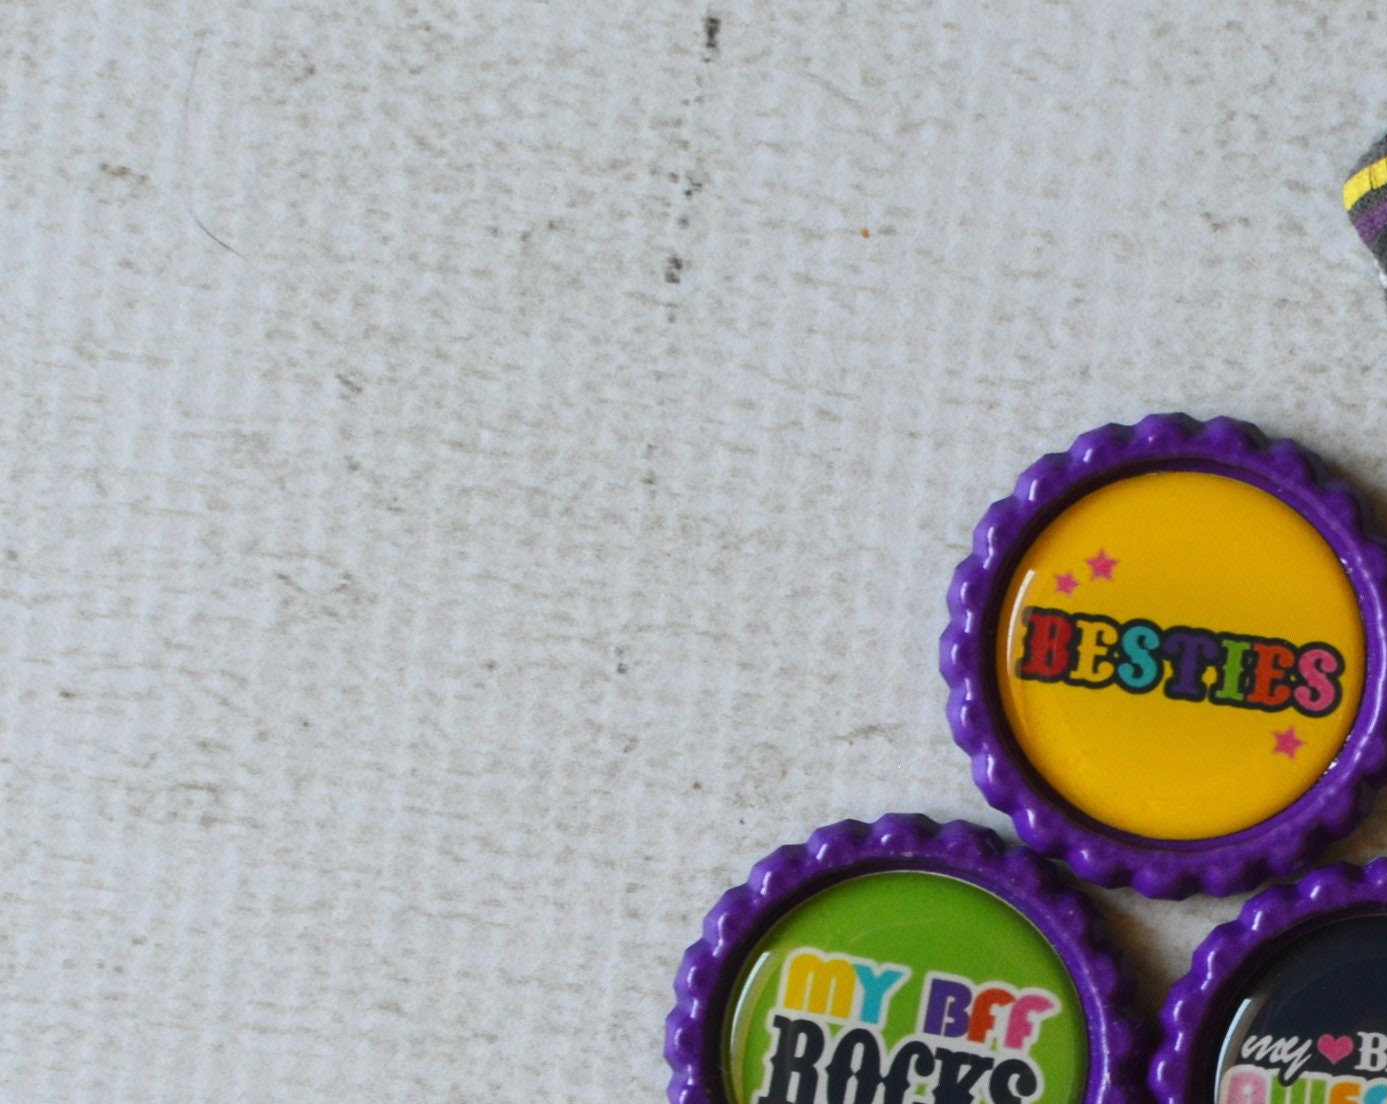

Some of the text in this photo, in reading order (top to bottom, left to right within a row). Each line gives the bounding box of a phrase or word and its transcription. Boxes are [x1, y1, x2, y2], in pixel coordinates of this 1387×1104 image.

[1017, 607, 1344, 717] BESTIES
[781, 950, 1057, 1051] MY BFF
[1240, 1033, 1313, 1080] my
